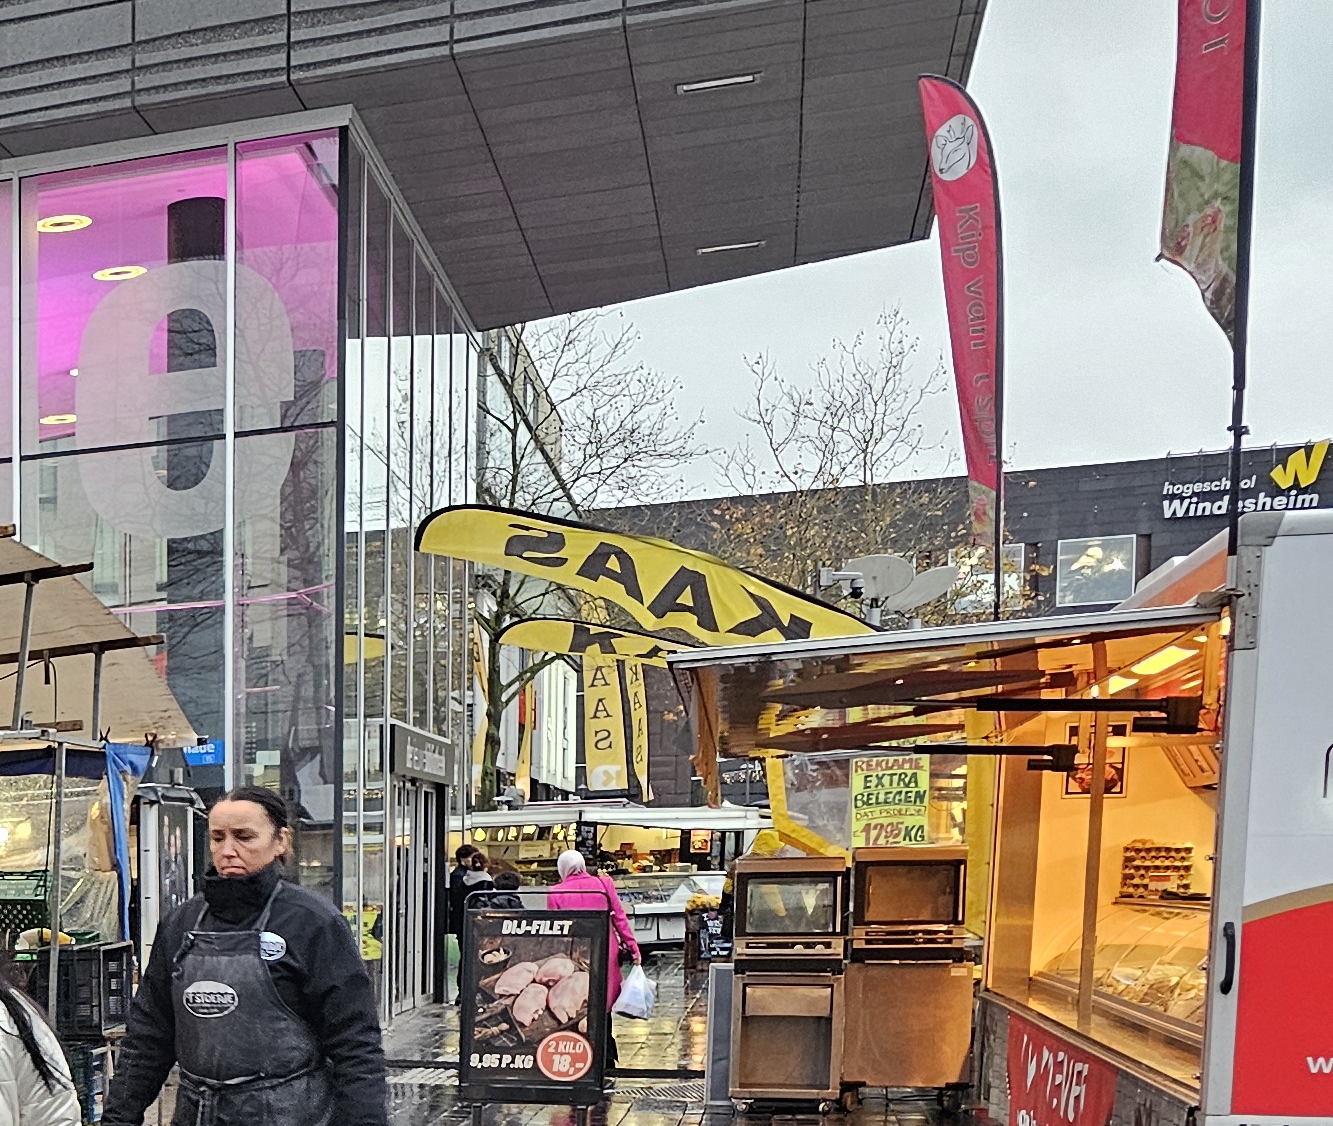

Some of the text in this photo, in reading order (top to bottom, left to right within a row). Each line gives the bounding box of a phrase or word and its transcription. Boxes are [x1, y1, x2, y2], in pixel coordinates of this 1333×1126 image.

[952, 203, 981, 269] Kip
[1162, 475, 1257, 496] hogeschol
[854, 757, 925, 774] REKLAME
[863, 772, 920, 790] EXTRA
[854, 789, 927, 809] BELEGEN
[903, 825, 925, 842] KG
[502, 919, 573, 935] DIJ-FILET
[547, 1041, 584, 1054] 2 KILO
[501, 1054, 534, 1069] P.KG
[552, 1055, 585, 1076] 18,-
